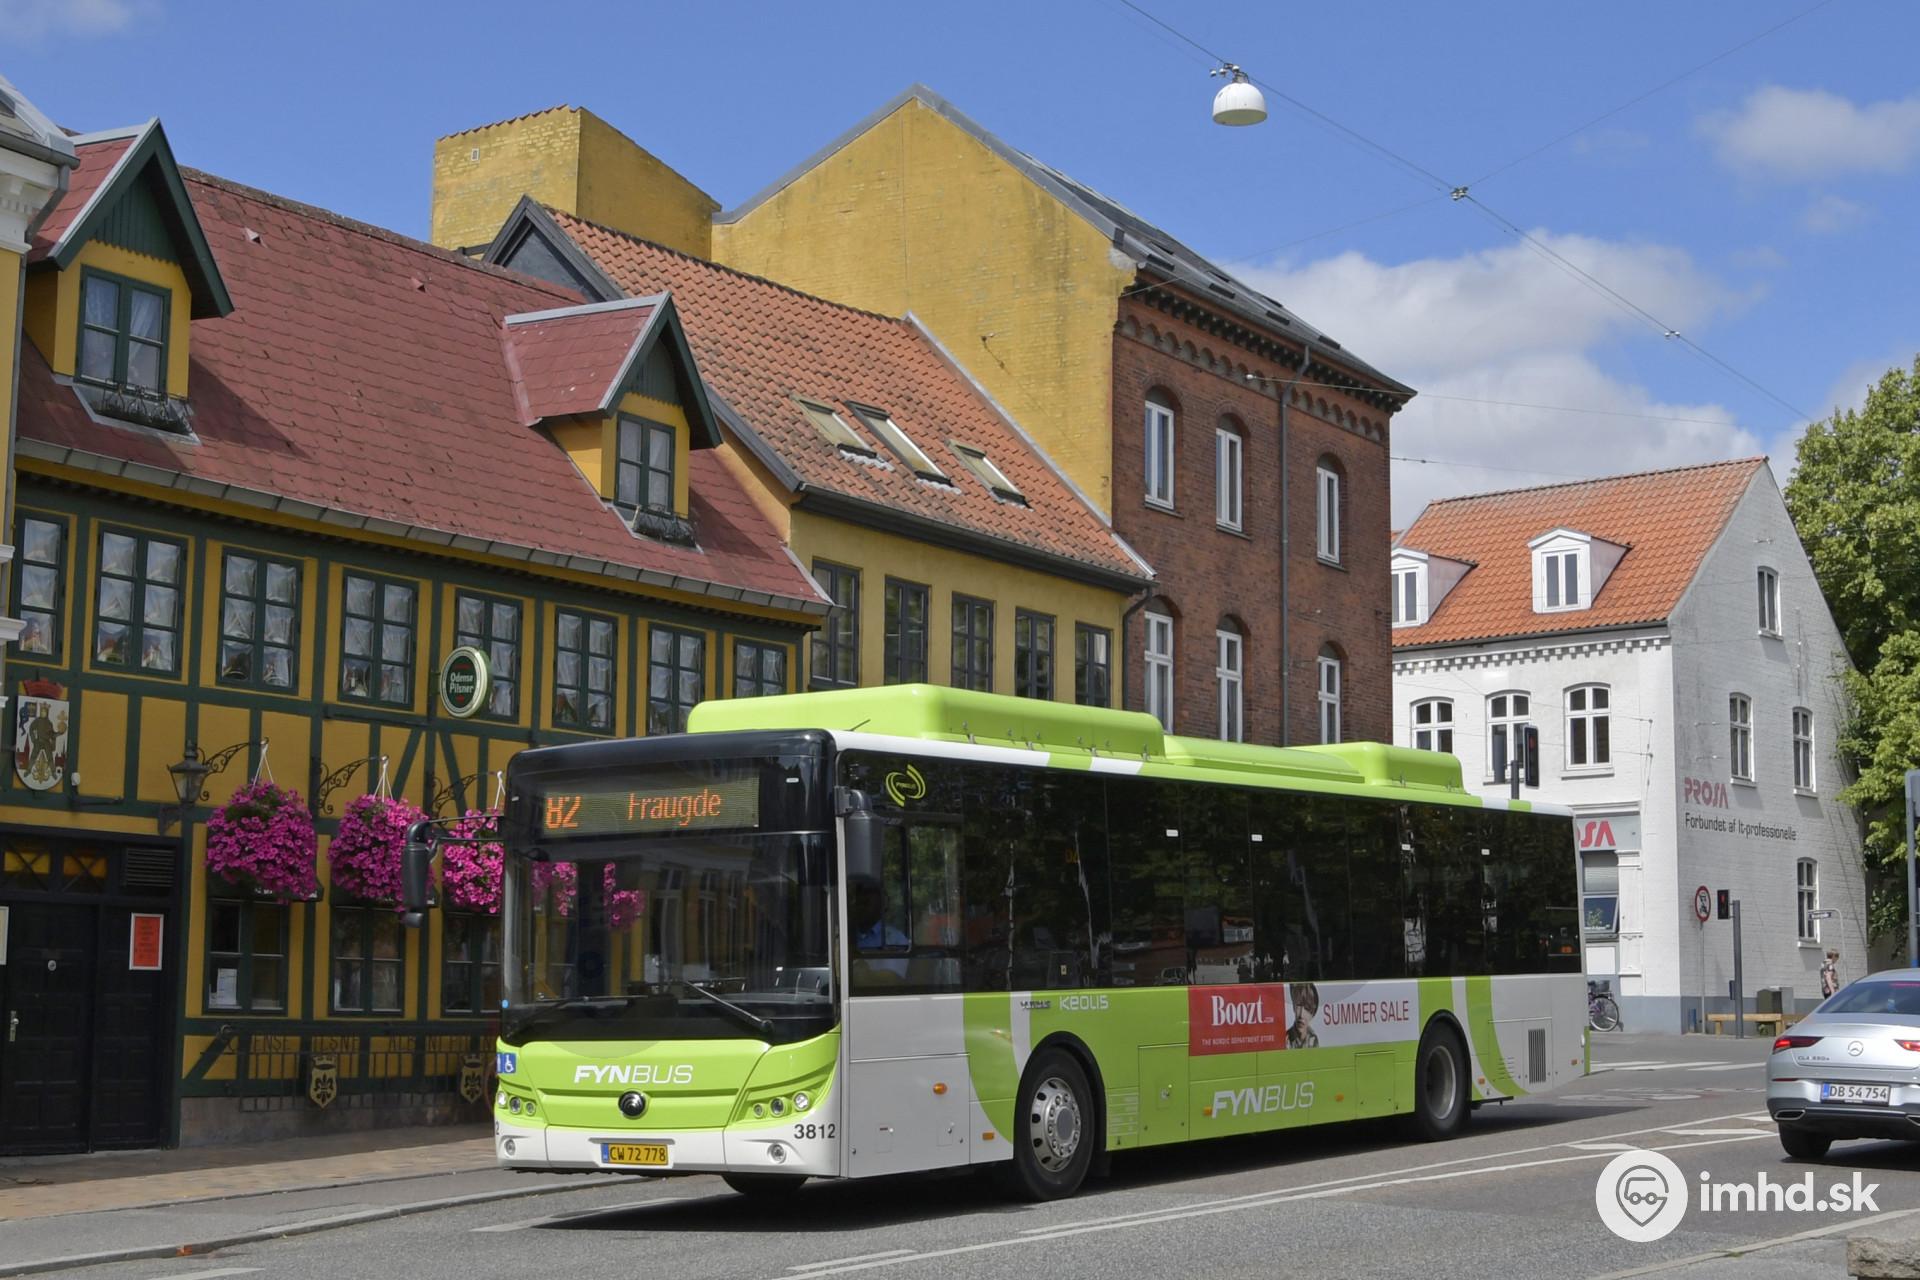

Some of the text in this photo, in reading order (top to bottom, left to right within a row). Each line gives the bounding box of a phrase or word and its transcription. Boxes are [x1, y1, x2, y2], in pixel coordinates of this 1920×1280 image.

[450, 672, 473, 682] Odense
[450, 683, 474, 693] Pilsner
[1684, 777, 1728, 809] PROSA
[546, 788, 721, 829] 82 Fraugde
[1577, 820, 1616, 848] SA
[1685, 812, 1797, 841] Forbundet af It-professionelle
[1323, 1000, 1409, 1025] SUMMER SALE
[573, 1065, 693, 1084] FYNBUS
[1212, 1081, 1314, 1118] FYNBUS
[1830, 1086, 1887, 1099] DB 54 754
[794, 1123, 836, 1139] 3812
[609, 1144, 667, 1161] CW 72 778
